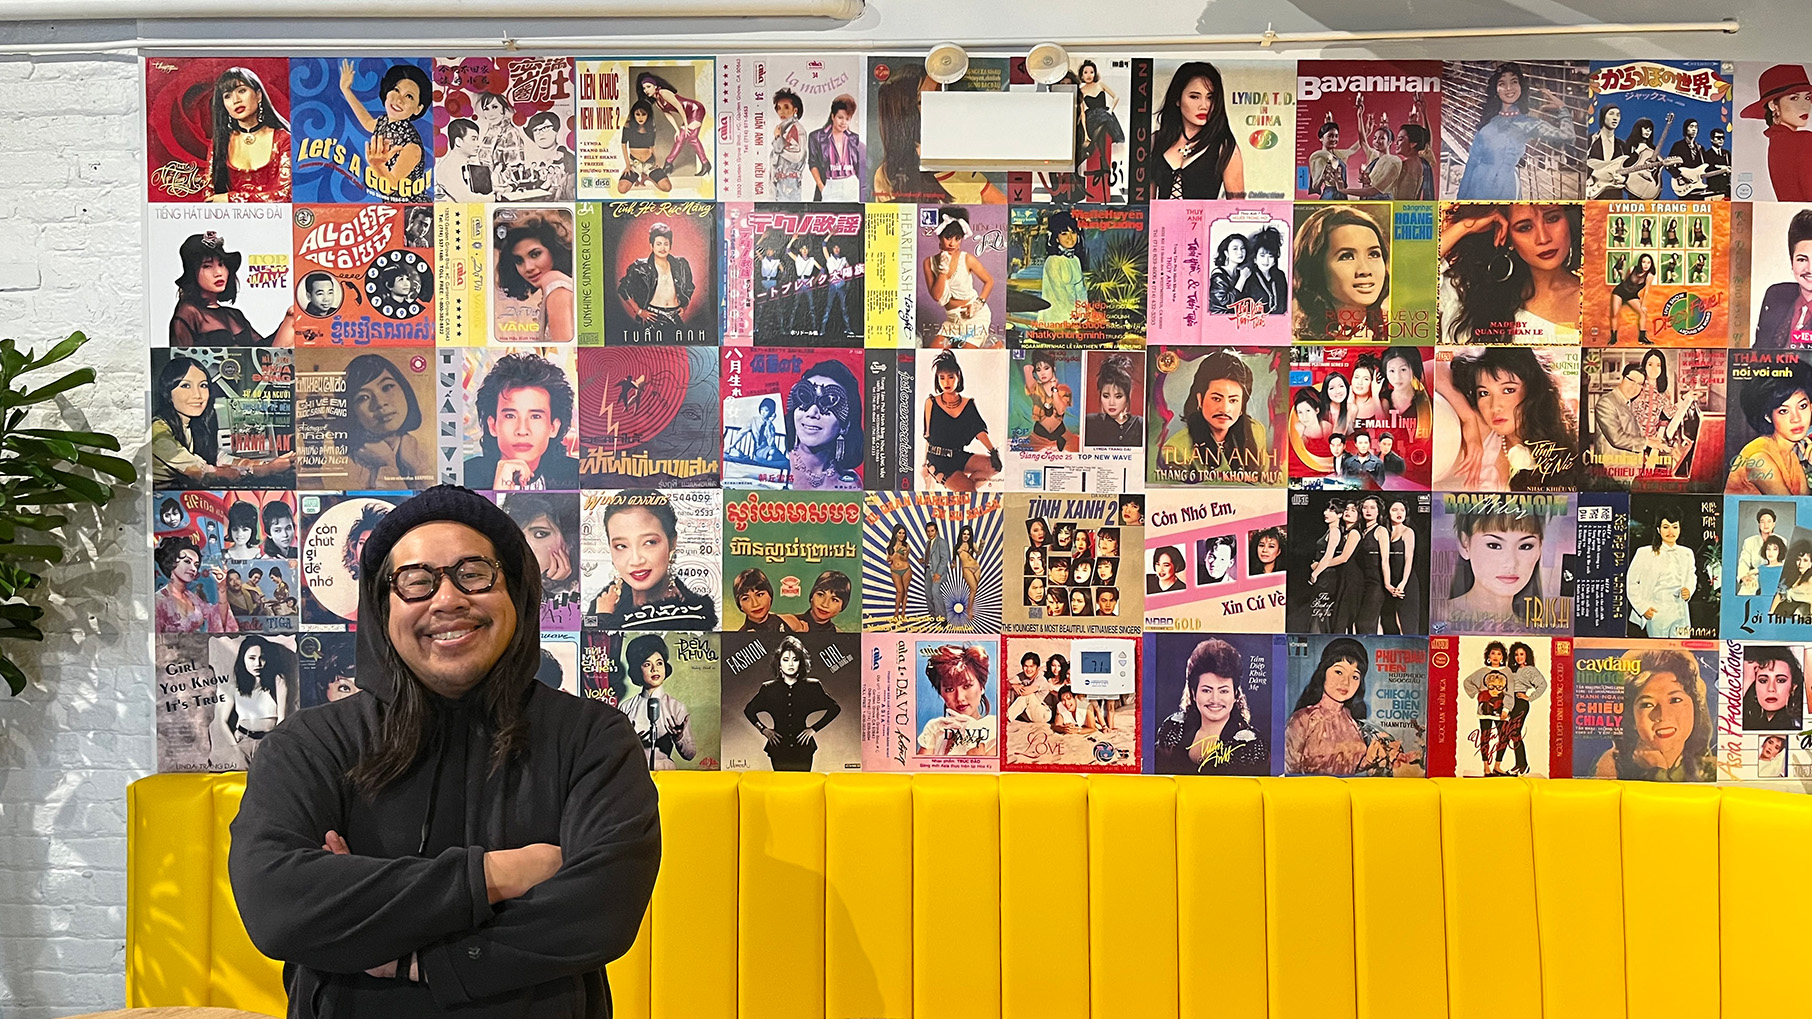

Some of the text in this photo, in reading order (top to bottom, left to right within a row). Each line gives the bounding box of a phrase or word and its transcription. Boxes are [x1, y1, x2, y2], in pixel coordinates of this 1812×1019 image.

[580, 68, 619, 100] LIÊN KHÚC
[786, 71, 798, 87] la
[1232, 92, 1268, 105] LYNDA
[580, 107, 620, 129] NEW WAVE 2
[1246, 115, 1281, 126] CHINA
[1137, 62, 1148, 201] NGỌC LAN
[297, 137, 346, 165] Let's
[349, 153, 361, 178] A
[155, 207, 181, 220] TIẾNG
[183, 207, 202, 220] HÁT
[204, 209, 230, 220] LINDA
[232, 209, 263, 220] TRANG
[1608, 204, 1711, 212] LYNDA TRANG DAI
[747, 213, 862, 235] テクノ歌謡
[250, 255, 287, 264] TOP
[248, 274, 287, 288] WAVE
[898, 212, 914, 340] HEART FLASH tonight
[624, 324, 706, 343] TUẤN ANH
[1772, 367, 1793, 378] anh
[1355, 409, 1417, 428] E-MAIL TÌNH
[1164, 442, 1277, 465] TUẤN ANH
[1730, 454, 1764, 472] Giao
[1155, 468, 1187, 482] THÁNG
[1190, 470, 1196, 481] 6
[1222, 468, 1258, 483] KHÔNG
[1260, 469, 1283, 483] MƯA
[694, 509, 714, 517] 2533
[866, 513, 881, 525] EL
[880, 499, 911, 514] GRAN
[931, 499, 1001, 520] EN SU SALSA
[1028, 499, 1118, 526] TÌNH XANH 2
[1181, 506, 1207, 522] Nhớ
[1211, 500, 1236, 517] Em,
[316, 523, 337, 535] còn
[309, 535, 334, 547] chút
[306, 548, 317, 560] gì
[700, 545, 713, 554] 20
[305, 562, 322, 574] để
[678, 568, 709, 577] 44099
[309, 575, 334, 587] nhớ
[1221, 589, 1287, 616] Xin Cứ Về
[1524, 597, 1569, 628] TRISH
[266, 616, 292, 630] TIGA
[1002, 624, 1141, 634] THE YOUNGEST & MOST BEAUTIFUL VIETNAMESE SINGERS
[1175, 618, 1201, 630] GOLD
[726, 638, 768, 675] FASHION
[819, 643, 845, 668] GIRL
[1092, 660, 1103, 672] 71
[1556, 662, 1564, 682] GOLD
[1716, 640, 1744, 781] Asia Productions
